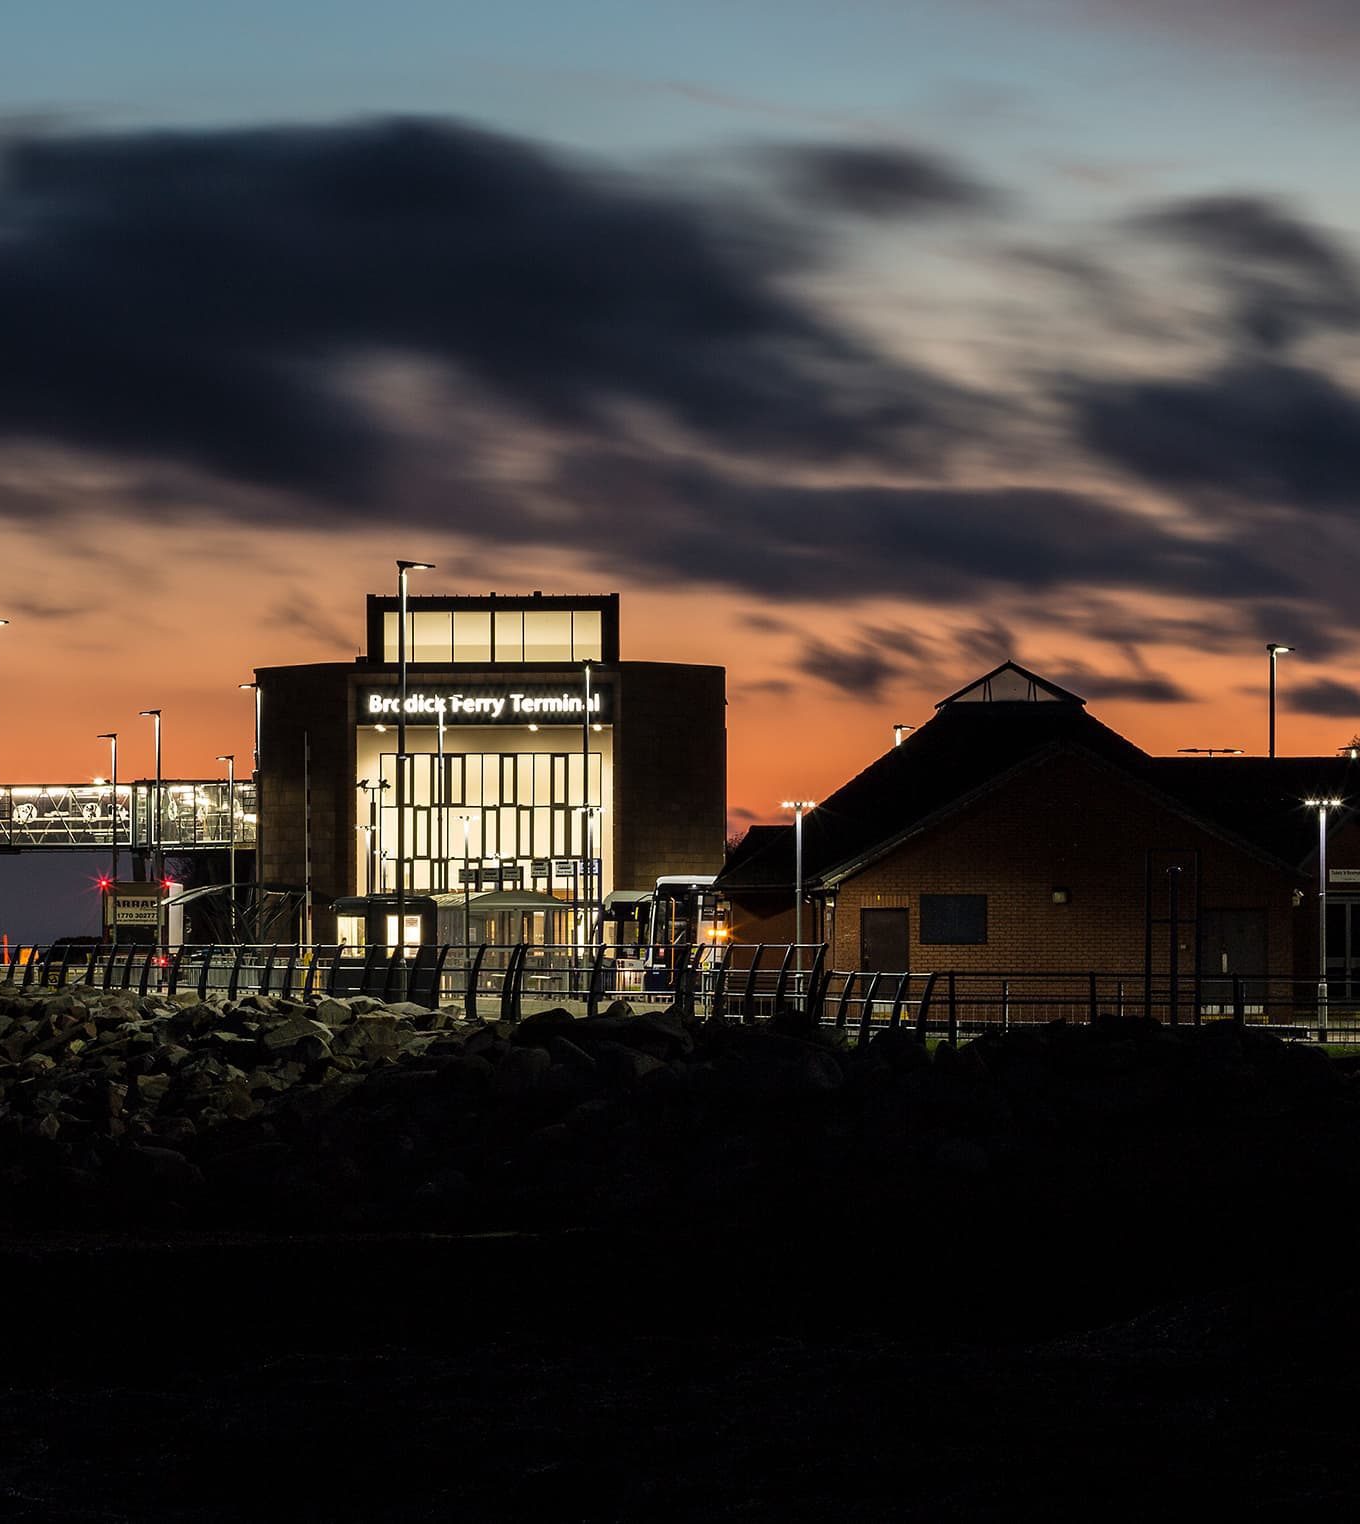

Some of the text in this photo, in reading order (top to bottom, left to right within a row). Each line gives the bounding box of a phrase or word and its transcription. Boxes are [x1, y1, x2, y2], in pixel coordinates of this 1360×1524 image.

[369, 694, 601, 718] Brodick Ferry Terminal
